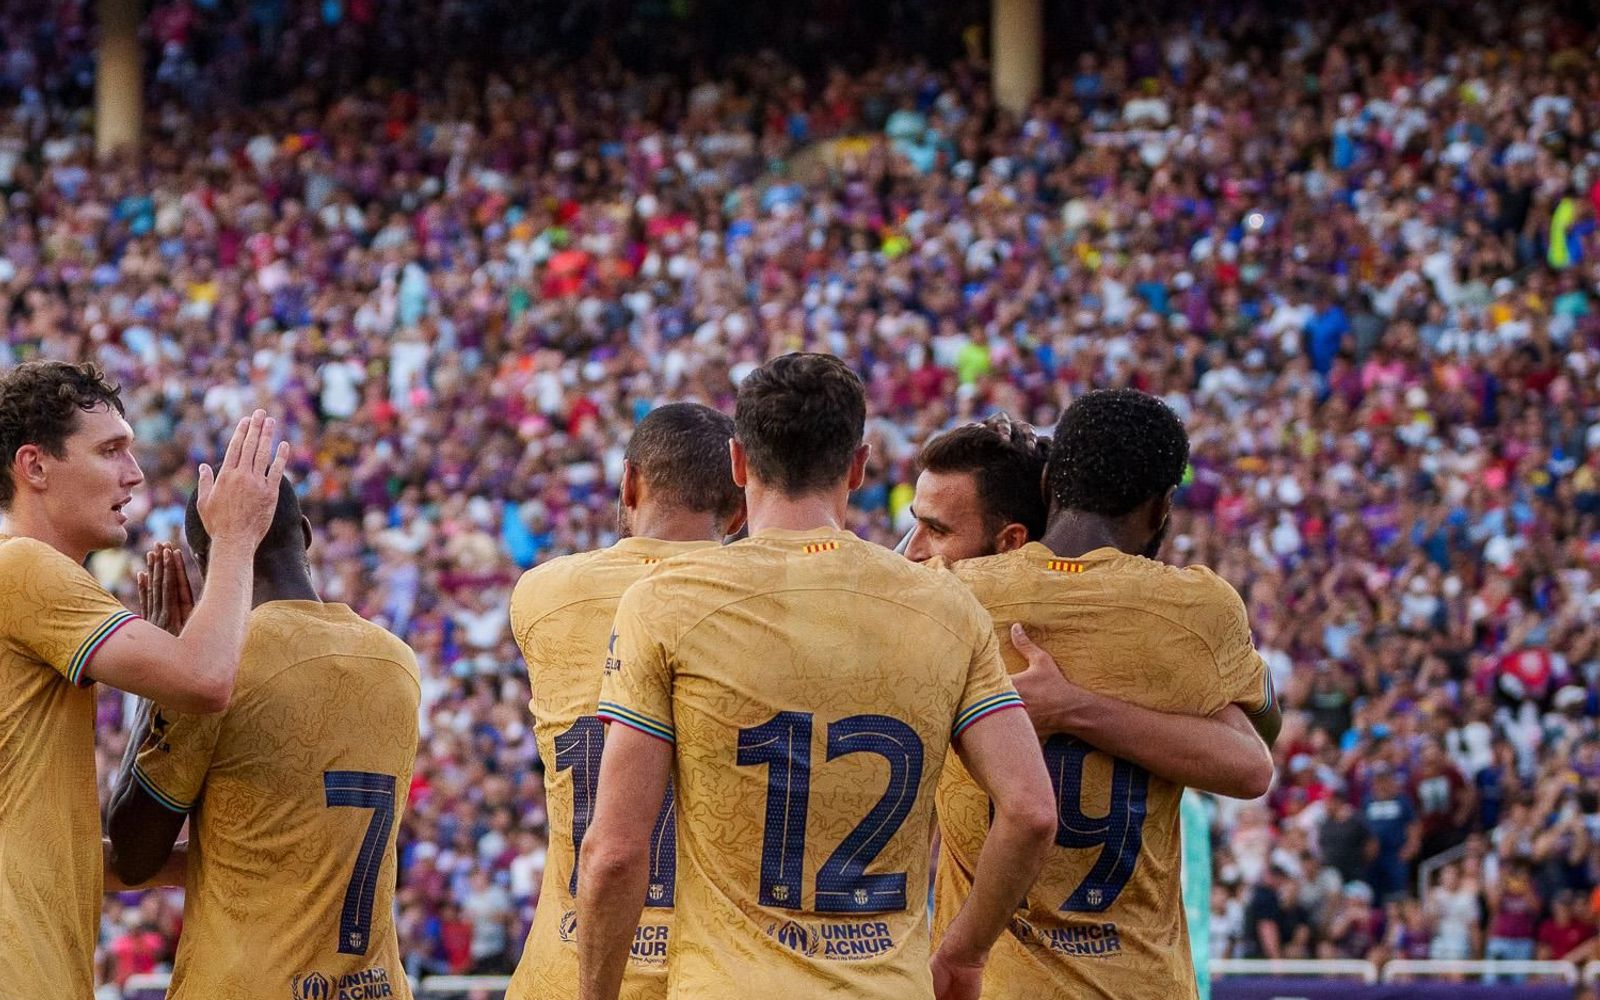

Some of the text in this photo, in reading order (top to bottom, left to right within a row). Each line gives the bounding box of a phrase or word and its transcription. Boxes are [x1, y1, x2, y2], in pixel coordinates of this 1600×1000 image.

[323, 770, 397, 956] 7
[736, 711, 925, 913] 12
[1018, 732, 1150, 913] 9
[821, 922, 890, 939] UNHCR
[824, 939, 894, 955] ACNUR
